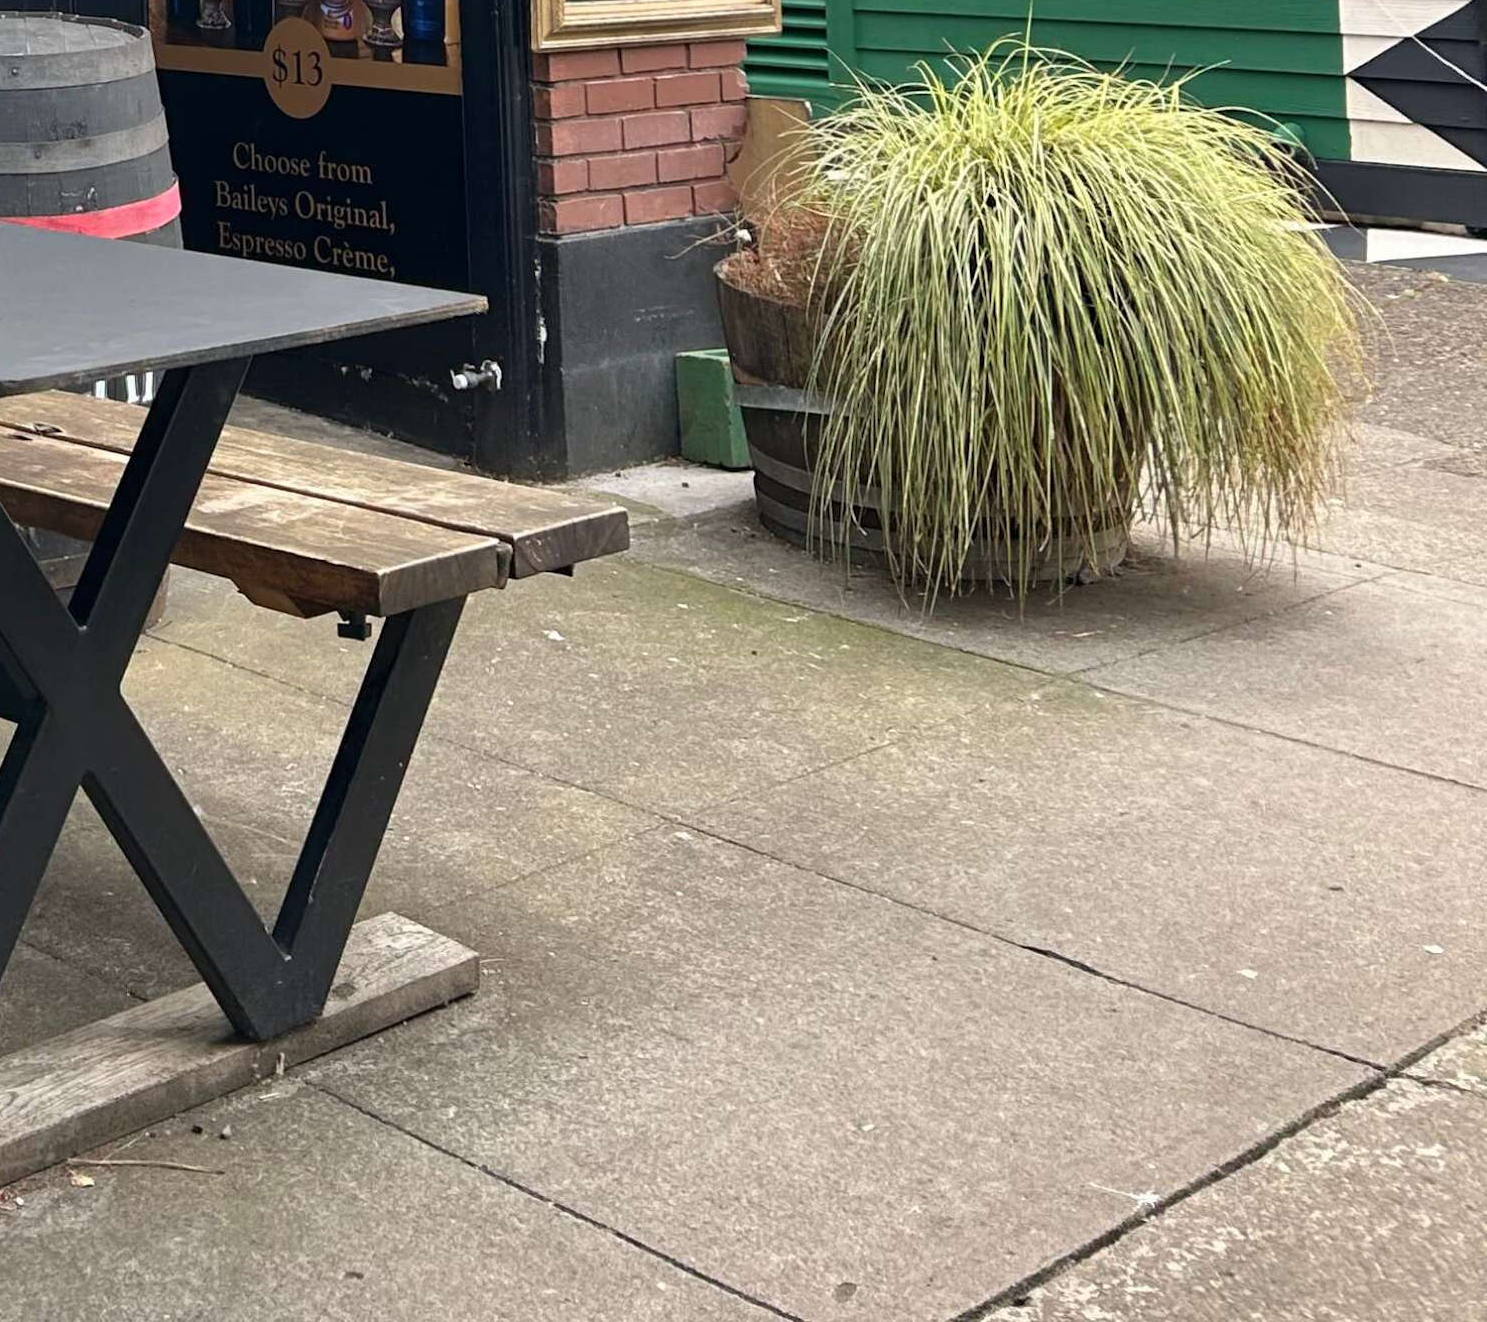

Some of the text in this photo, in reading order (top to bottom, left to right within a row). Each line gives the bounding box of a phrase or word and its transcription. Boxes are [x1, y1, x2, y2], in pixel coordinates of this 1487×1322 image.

[272, 44, 323, 87] $13
[233, 141, 373, 185] Choose from
[215, 179, 396, 235] Baileys Original,
[217, 221, 396, 278] Espresso Crème,
